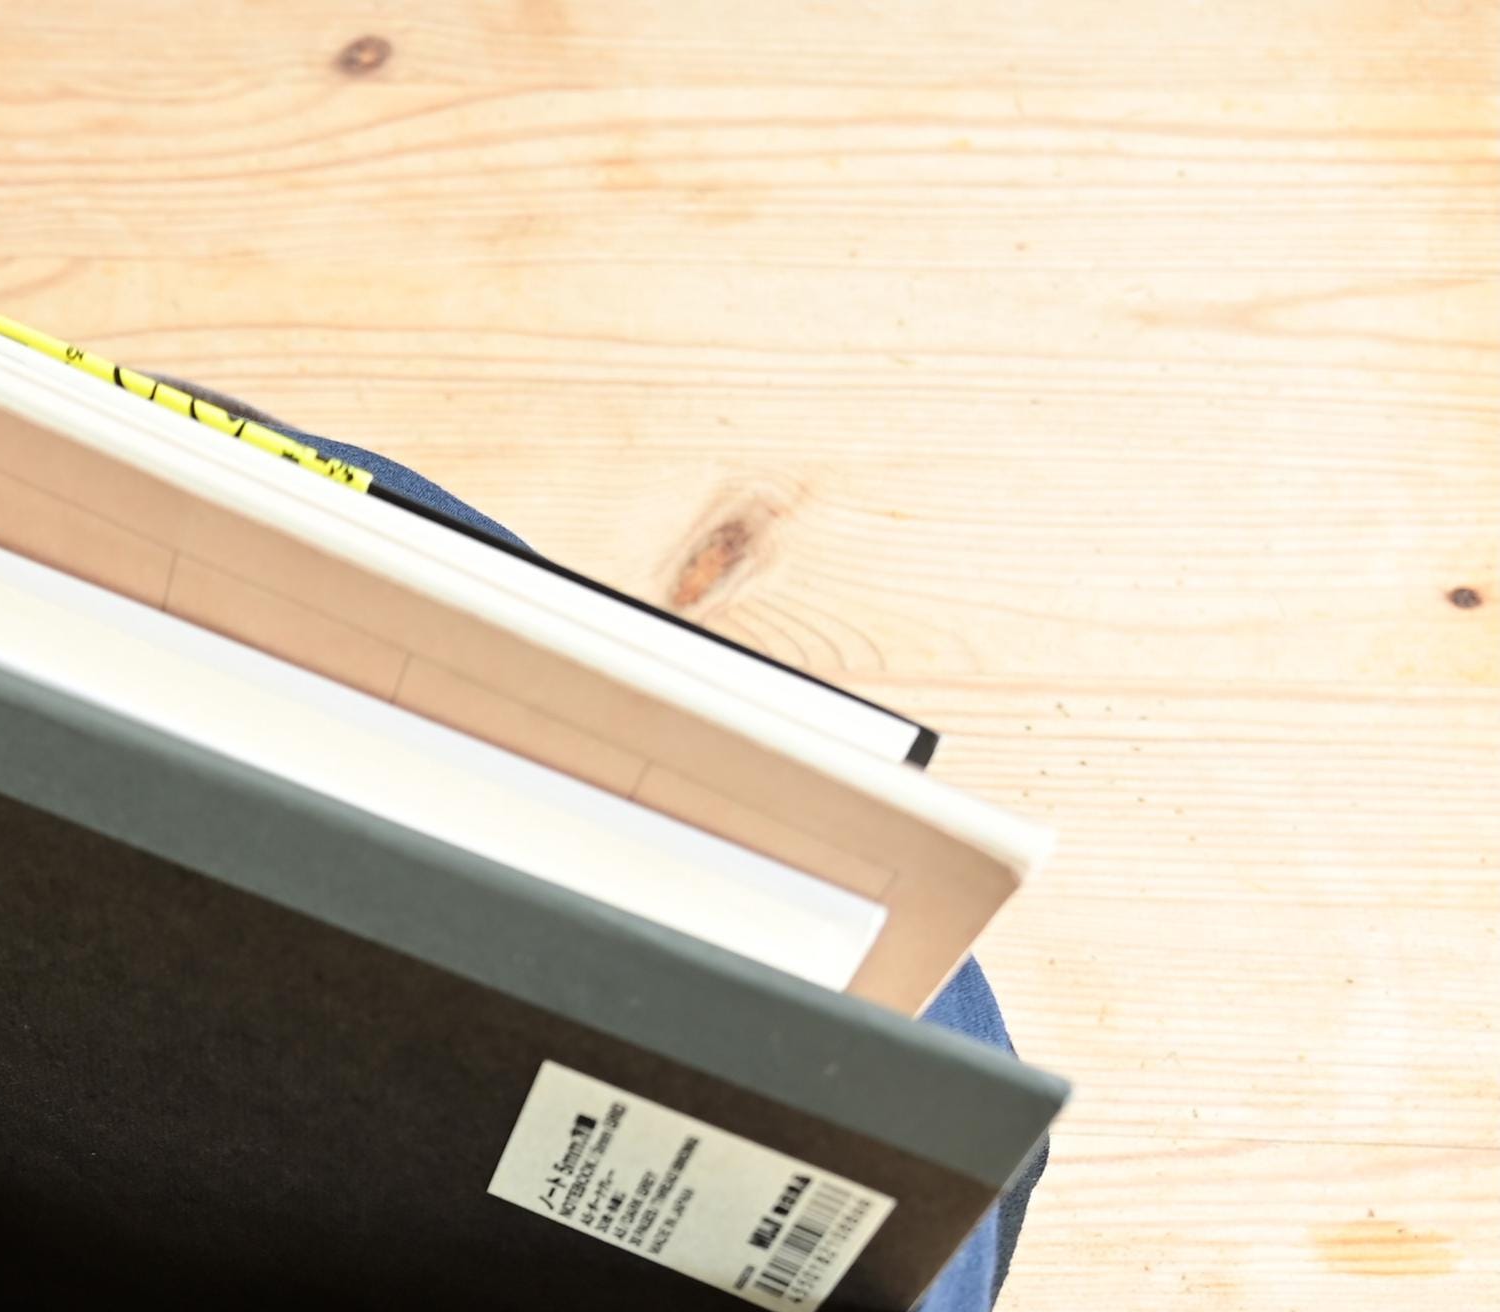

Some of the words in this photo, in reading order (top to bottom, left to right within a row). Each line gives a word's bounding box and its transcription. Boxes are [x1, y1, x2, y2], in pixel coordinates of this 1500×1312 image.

[535, 1173, 567, 1210] ノート
[557, 1159, 597, 1219] NOTEBOOK
